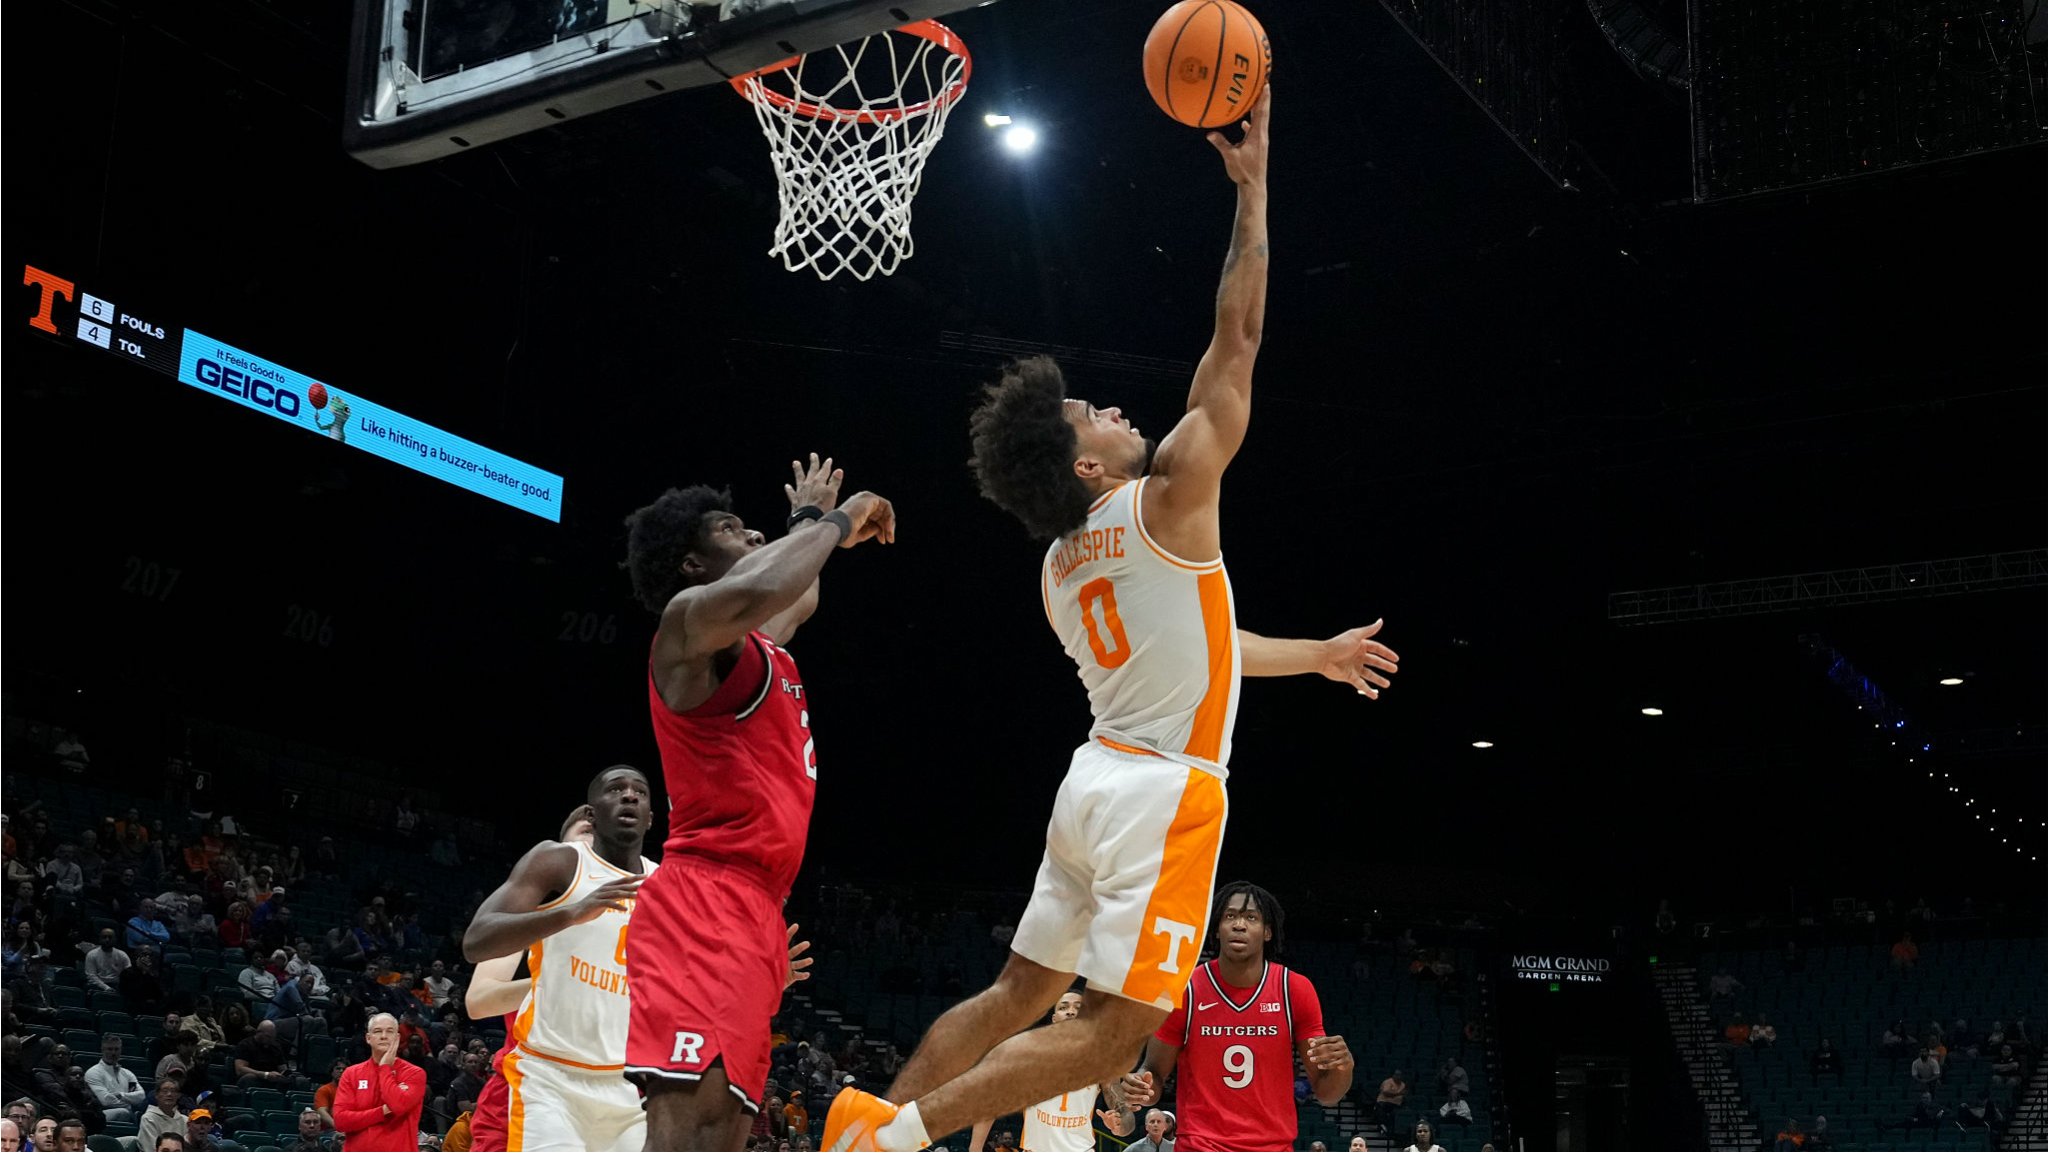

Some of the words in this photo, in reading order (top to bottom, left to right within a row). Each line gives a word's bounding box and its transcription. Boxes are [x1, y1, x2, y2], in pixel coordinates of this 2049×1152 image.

[92, 301, 102, 315] 6
[120, 313, 165, 340] FOULS
[88, 326, 99, 341] 4
[118, 338, 146, 359] TOL
[216, 349, 225, 360] It
[225, 351, 248, 370] Feels
[250, 362, 274, 380] Good
[275, 372, 285, 384] to
[195, 357, 300, 418] GEICO
[361, 417, 386, 439] Like
[388, 427, 428, 458] hitting
[430, 447, 437, 458] a
[439, 447, 520, 490] buzzer-beater
[521, 482, 552, 502] good.
[1051, 526, 1125, 588] GILLESPIE
[120, 554, 183, 602] 207
[282, 604, 334, 648] 206
[556, 610, 617, 644] 206
[1078, 577, 1131, 669] 0
[1153, 916, 1197, 974] T
[1511, 955, 1551, 969] MGM
[1554, 956, 1609, 972] GRAND
[570, 955, 631, 996] VOLUNT
[1517, 971, 1561, 981] GARDEN
[1566, 974, 1602, 983] ARENA
[670, 1031, 704, 1064] R
[1200, 1025, 1278, 1036] RUTGERS
[1222, 1044, 1254, 1089] 9
[1036, 1108, 1088, 1128] VOLUNTEERS
